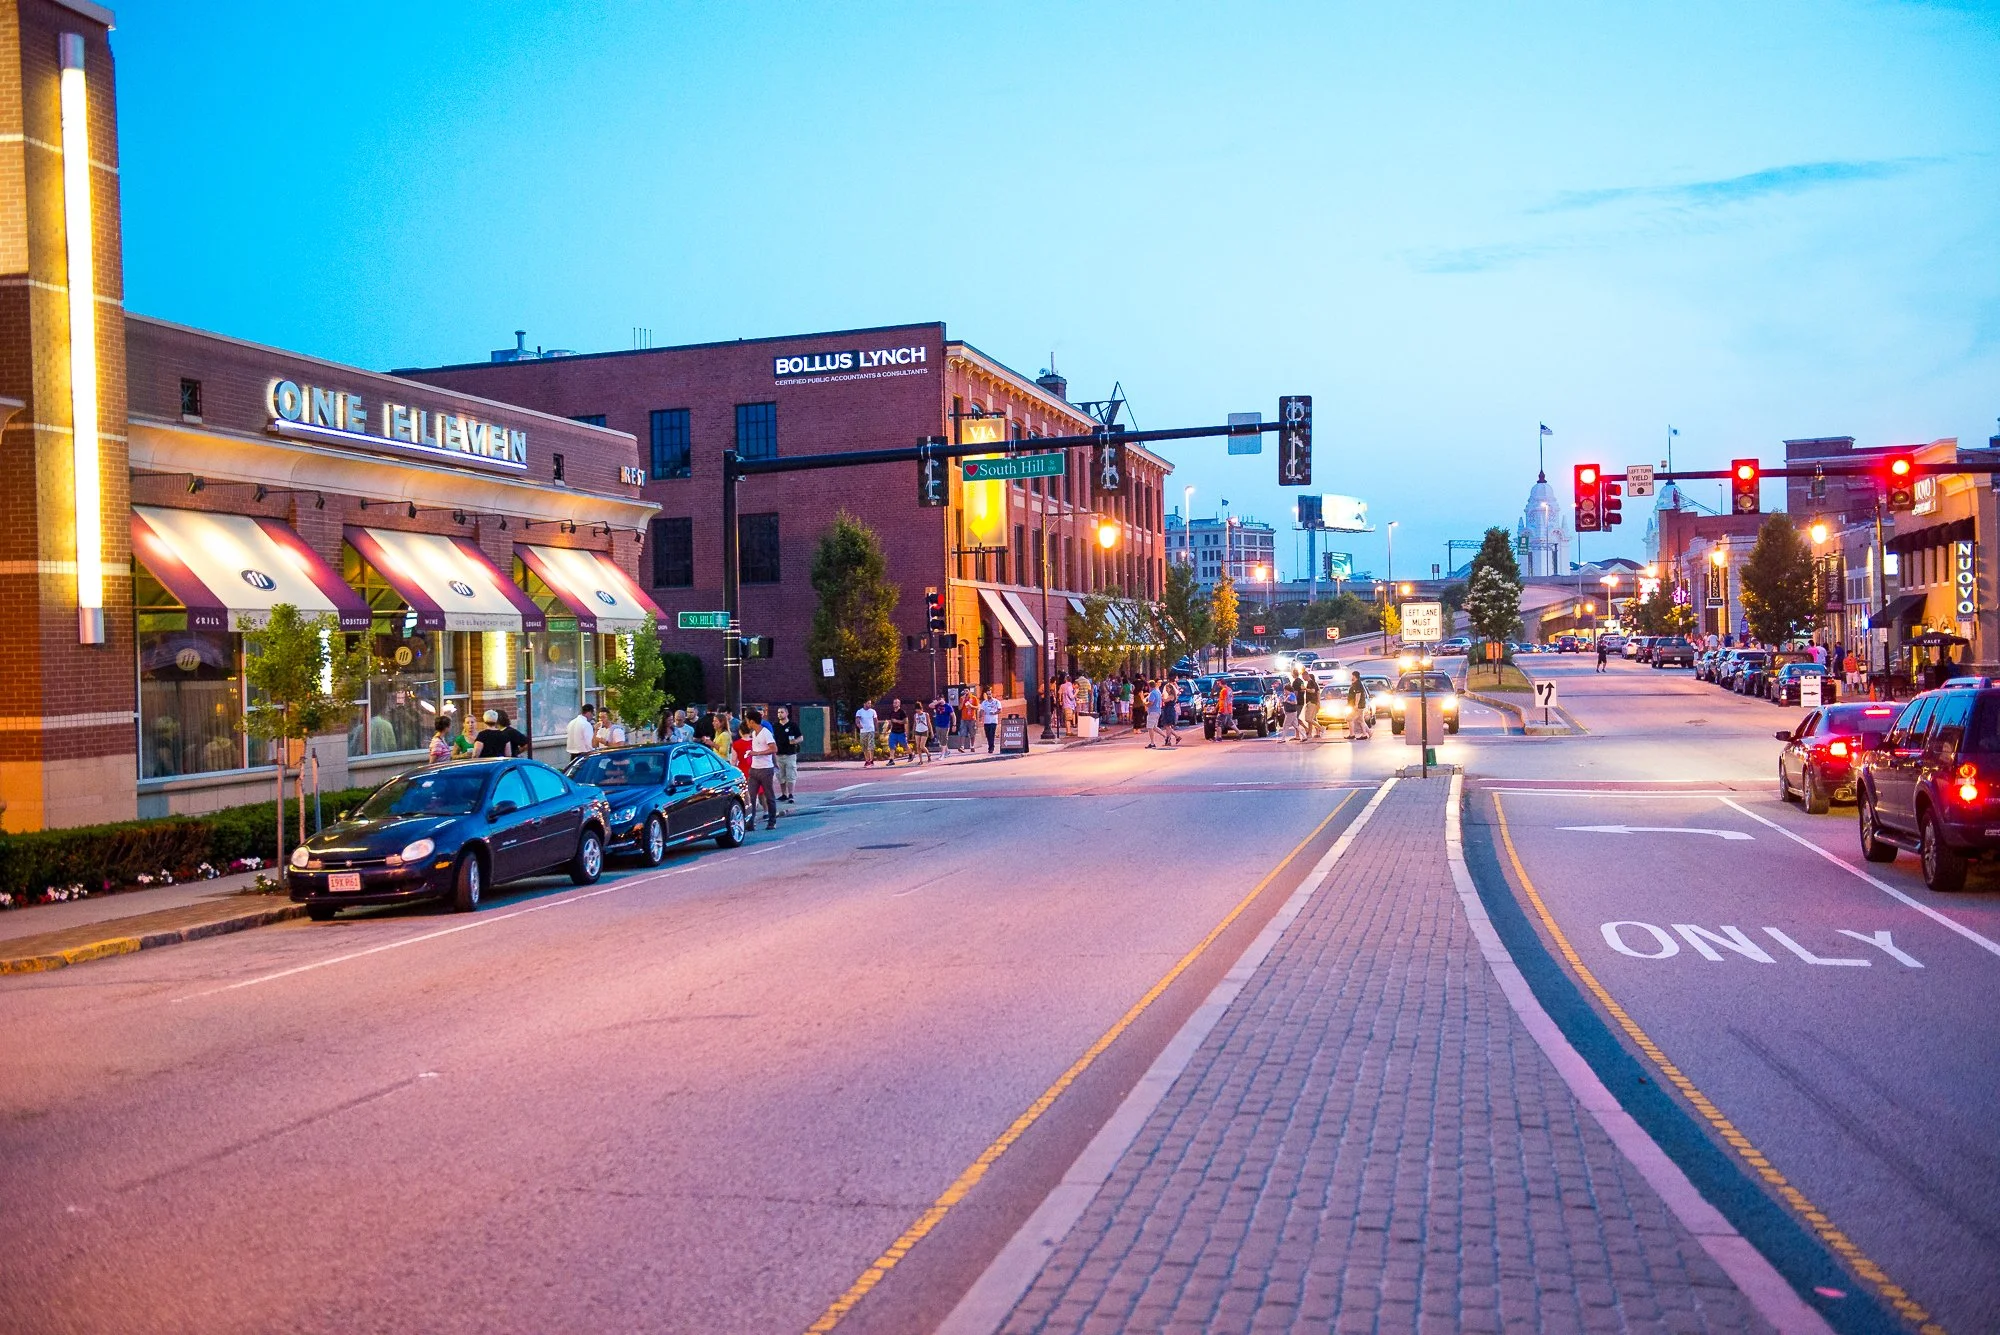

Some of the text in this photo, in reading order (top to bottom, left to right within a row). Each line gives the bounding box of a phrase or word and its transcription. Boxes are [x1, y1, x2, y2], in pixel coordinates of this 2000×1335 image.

[775, 346, 926, 375] BOLLUS LYNCH
[775, 378, 807, 386] CERTIFIED
[807, 376, 830, 384] PUBLIC
[830, 373, 876, 382] ACCOUNTANTS
[882, 368, 928, 377] CONSULTANTS
[272, 380, 527, 464] ONE ELEVEN
[969, 426, 997, 440] VIA
[620, 466, 646, 487] REST
[979, 462, 1017, 476] South
[1021, 459, 1044, 474] Hill
[1957, 543, 1974, 614] NUOVO
[195, 616, 220, 625] GRILL
[689, 615, 699, 625] SO.
[1412, 618, 1430, 626] MUST
[1600, 920, 1925, 968] ONLY
